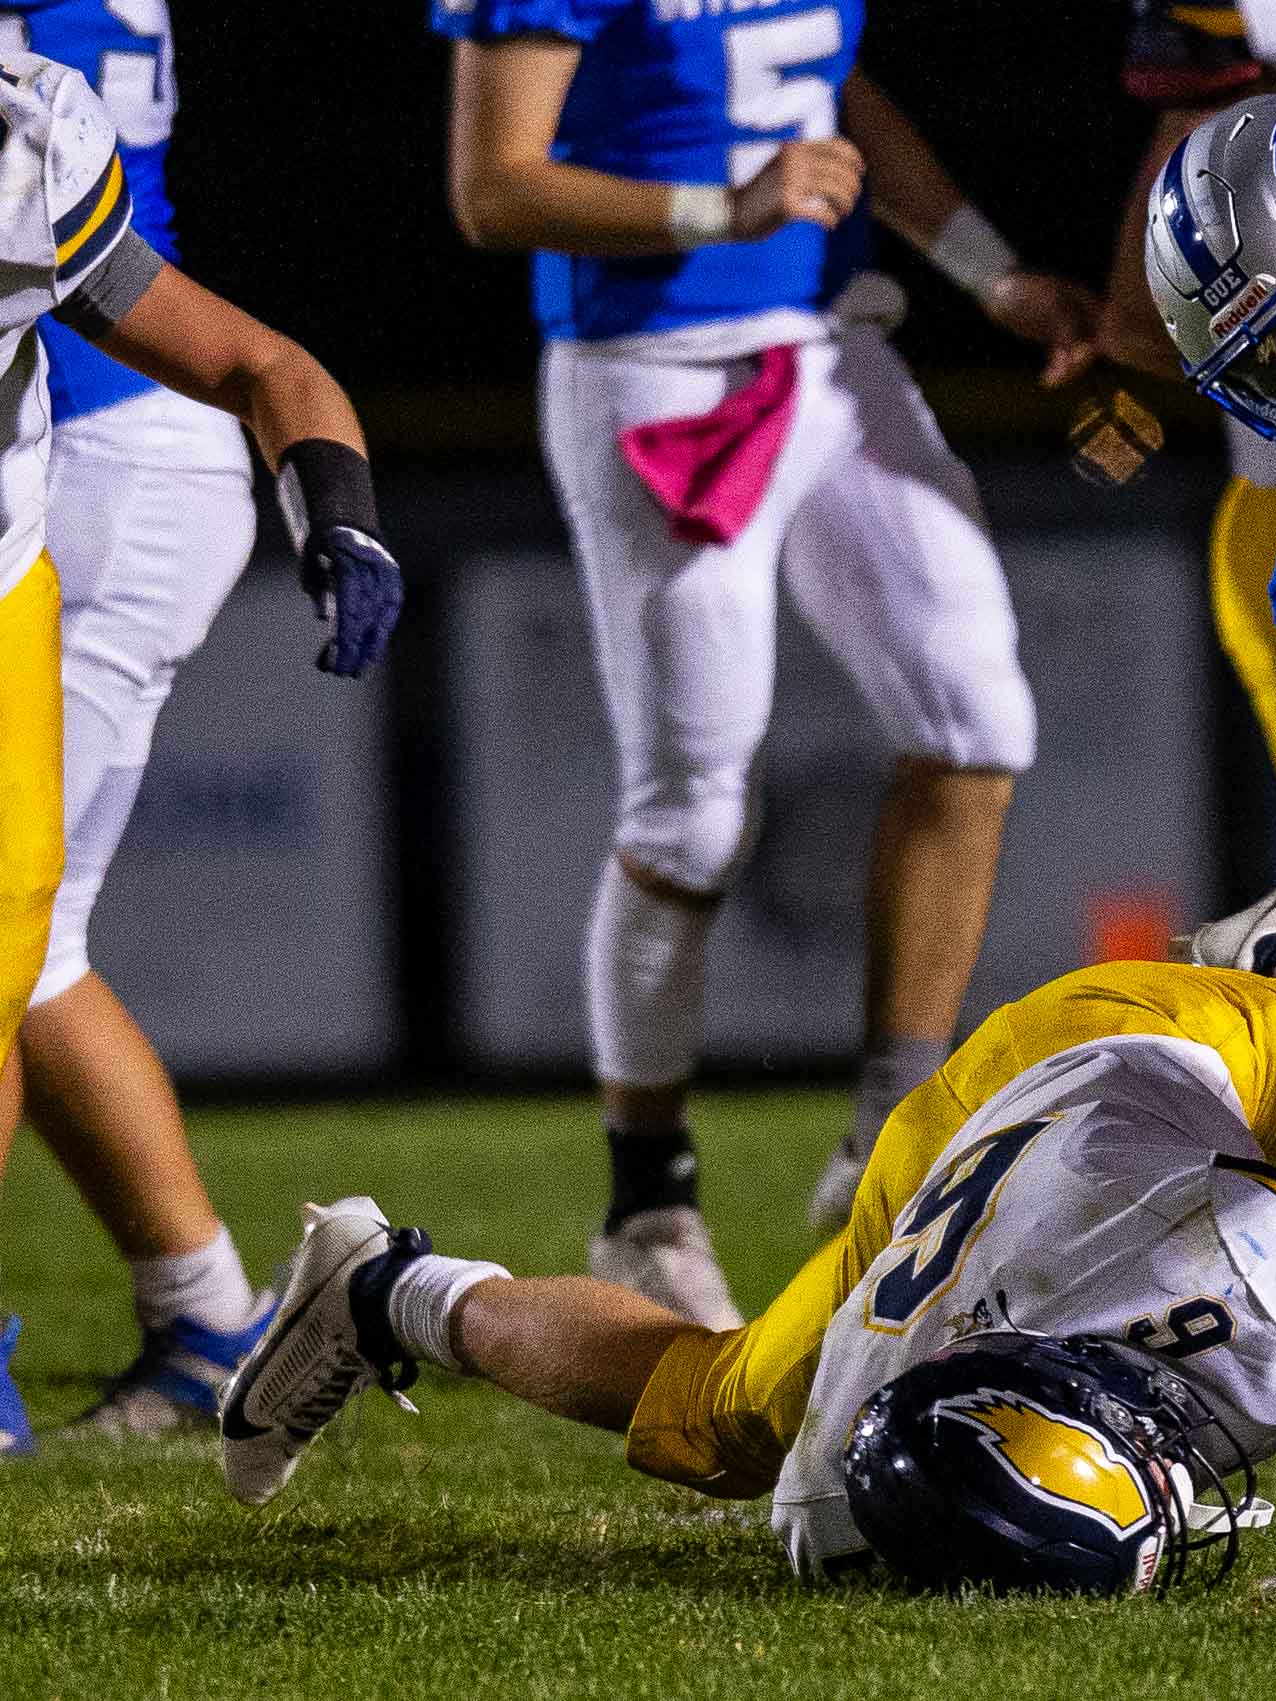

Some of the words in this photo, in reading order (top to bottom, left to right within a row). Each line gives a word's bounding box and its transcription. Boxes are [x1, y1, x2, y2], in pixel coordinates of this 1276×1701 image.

[725, 6, 842, 191] 5
[1203, 267, 1242, 307] GUE
[1213, 282, 1268, 338] Riddell
